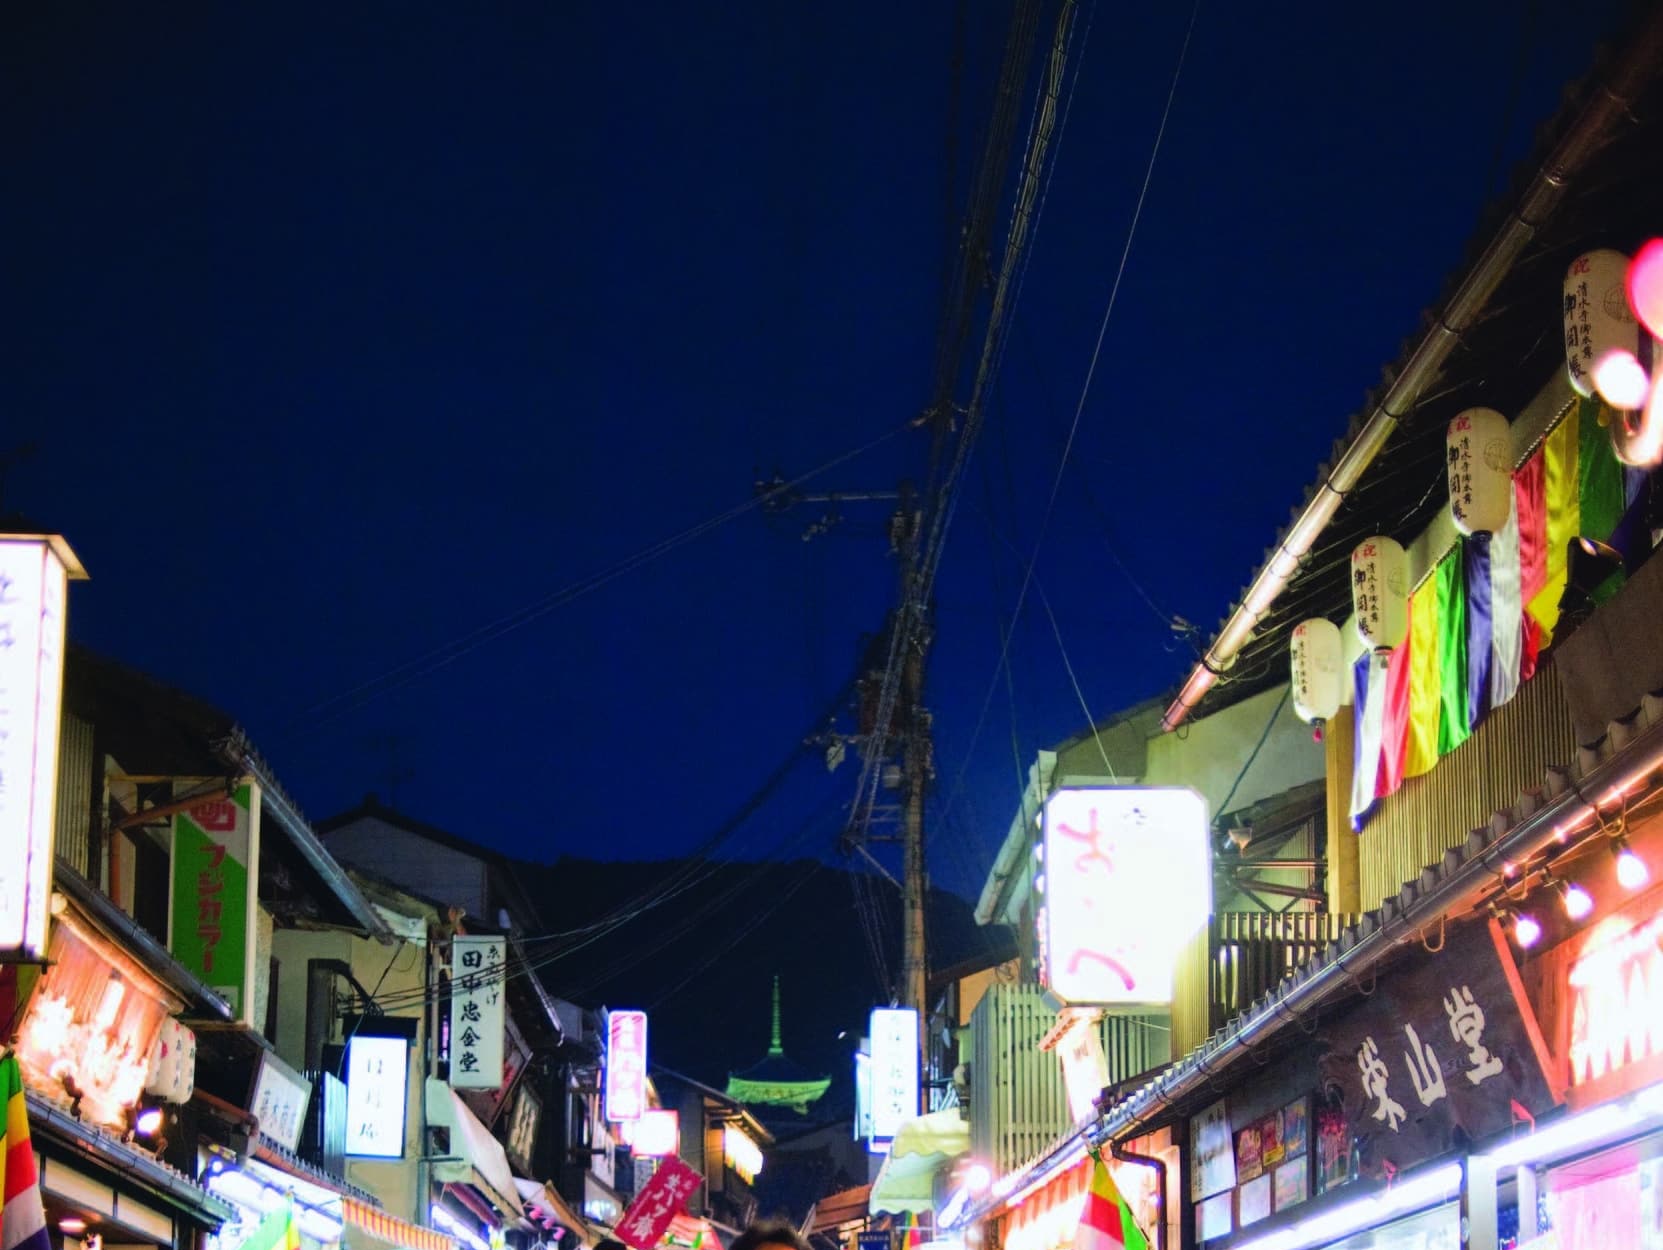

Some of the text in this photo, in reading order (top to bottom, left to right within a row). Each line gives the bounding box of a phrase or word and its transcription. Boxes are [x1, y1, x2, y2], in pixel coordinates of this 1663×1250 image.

[196, 844, 226, 974] フジカラー
